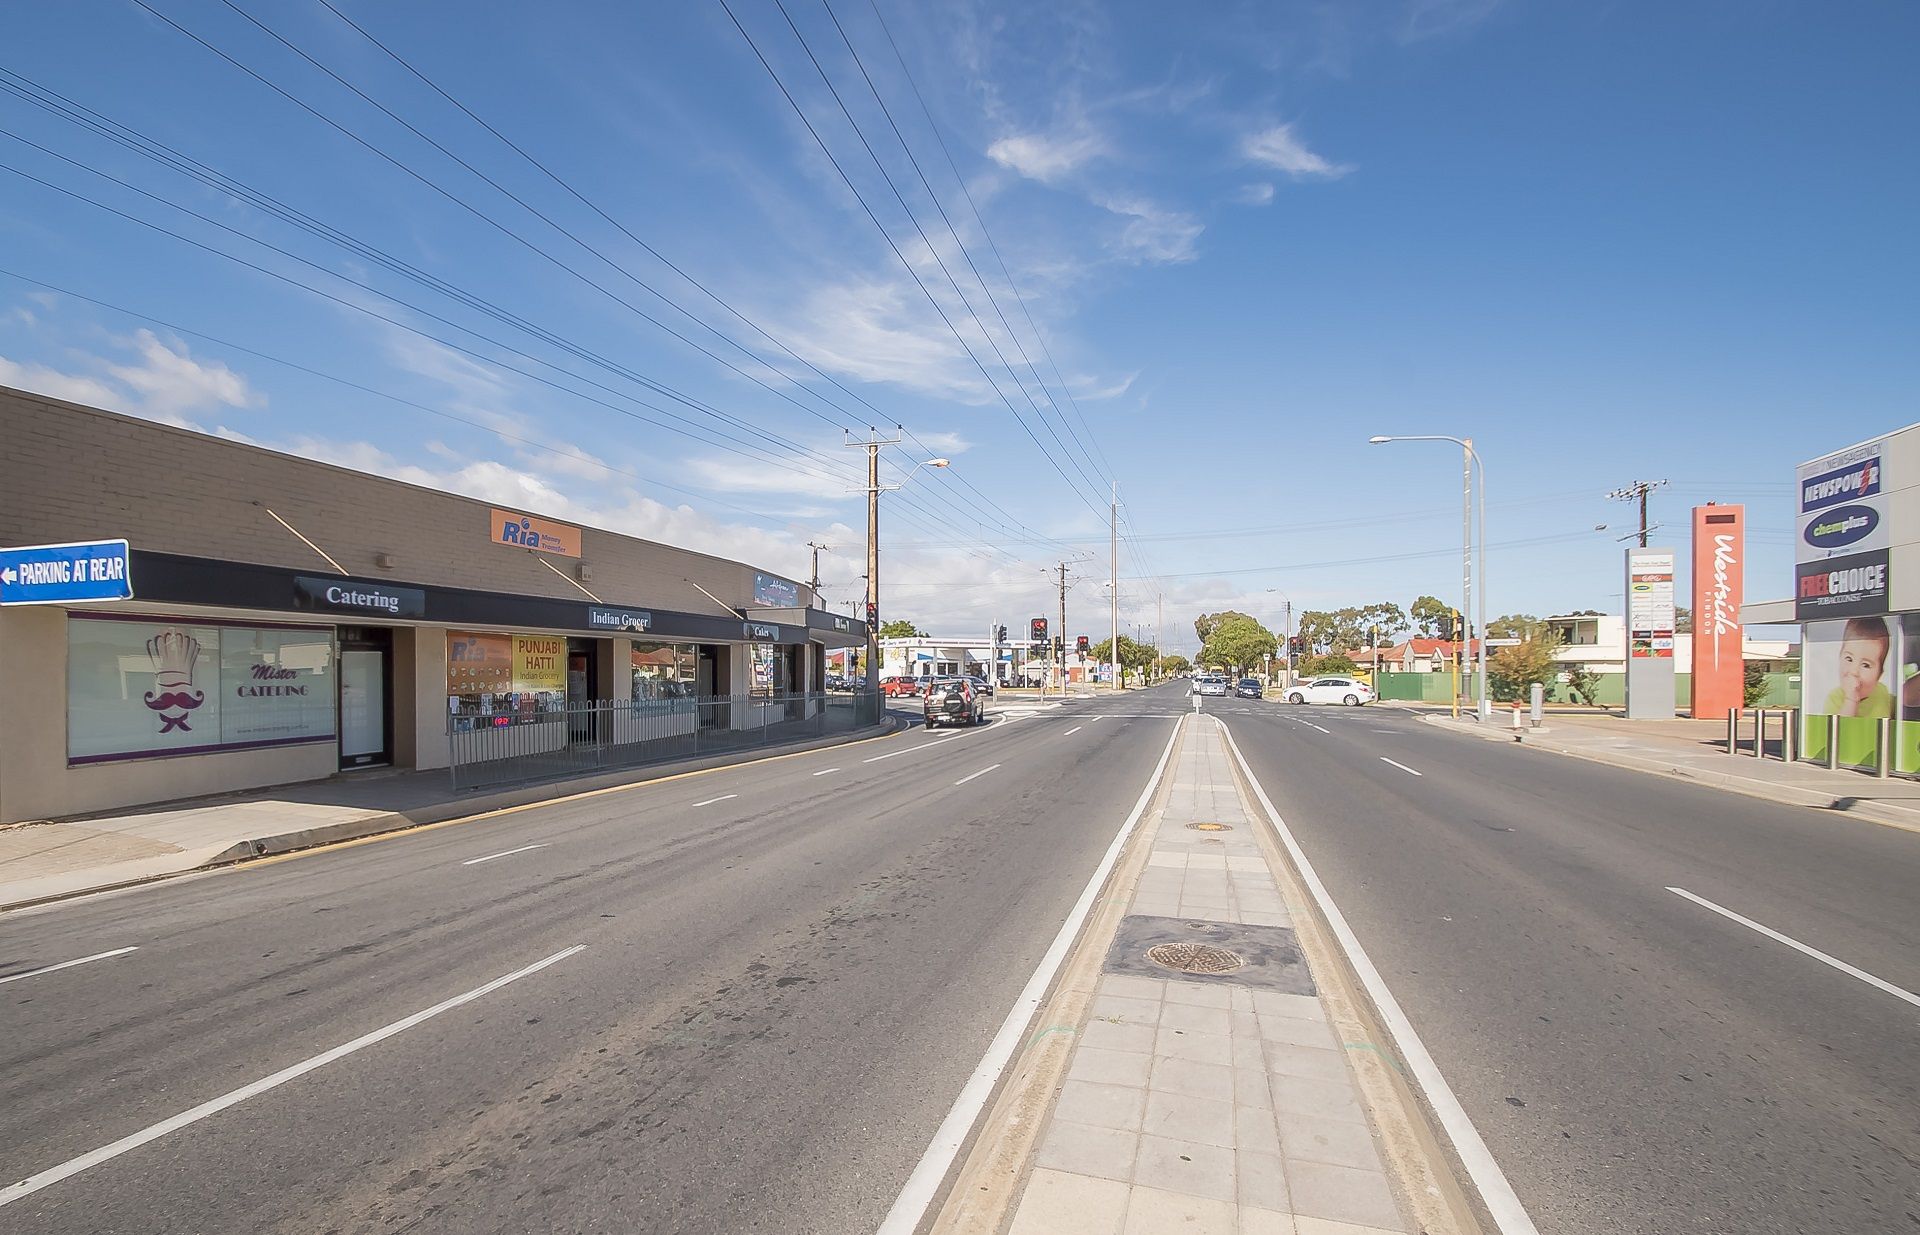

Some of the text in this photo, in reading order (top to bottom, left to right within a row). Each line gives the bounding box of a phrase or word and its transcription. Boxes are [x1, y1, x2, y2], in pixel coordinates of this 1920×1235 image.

[502, 518, 540, 548] Ria
[1813, 515, 1869, 537] chemplus
[19, 556, 124, 585] PARKING AT REAR
[326, 586, 399, 613] Catering
[592, 611, 649, 627] Indian Grocer
[518, 639, 561, 655] PUNJABI
[526, 656, 555, 670] HATTI
[251, 663, 297, 680] Mister
[519, 671, 560, 681] Indian Grocery
[237, 685, 309, 697] CATERING
